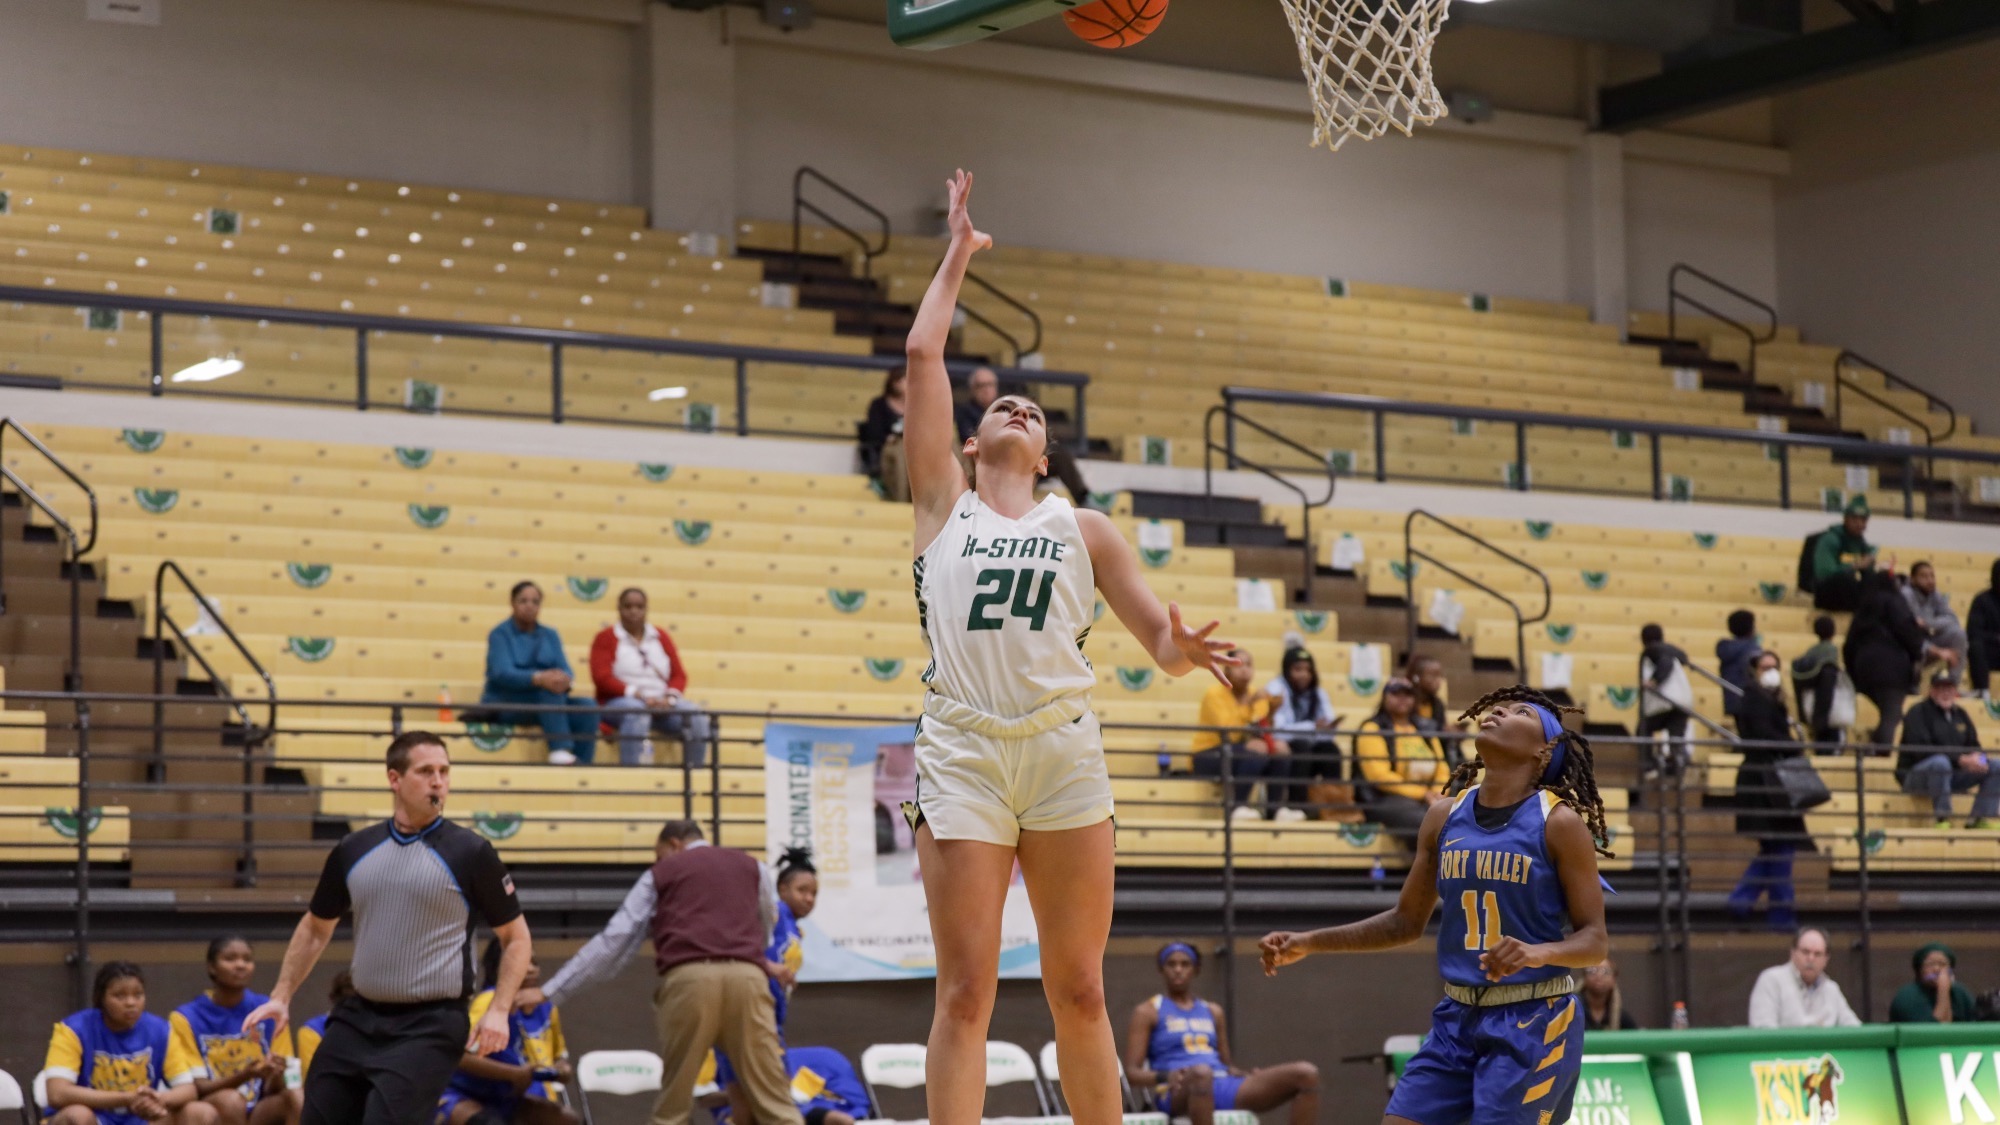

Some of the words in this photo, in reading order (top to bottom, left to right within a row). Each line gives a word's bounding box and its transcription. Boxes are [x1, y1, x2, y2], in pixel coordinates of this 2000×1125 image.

[961, 535, 1066, 562] K-STATE
[966, 568, 1057, 632] 24
[1440, 850, 1470, 880] FORT
[1476, 850, 1533, 885] VALLEY
[1461, 889, 1503, 951] 11
